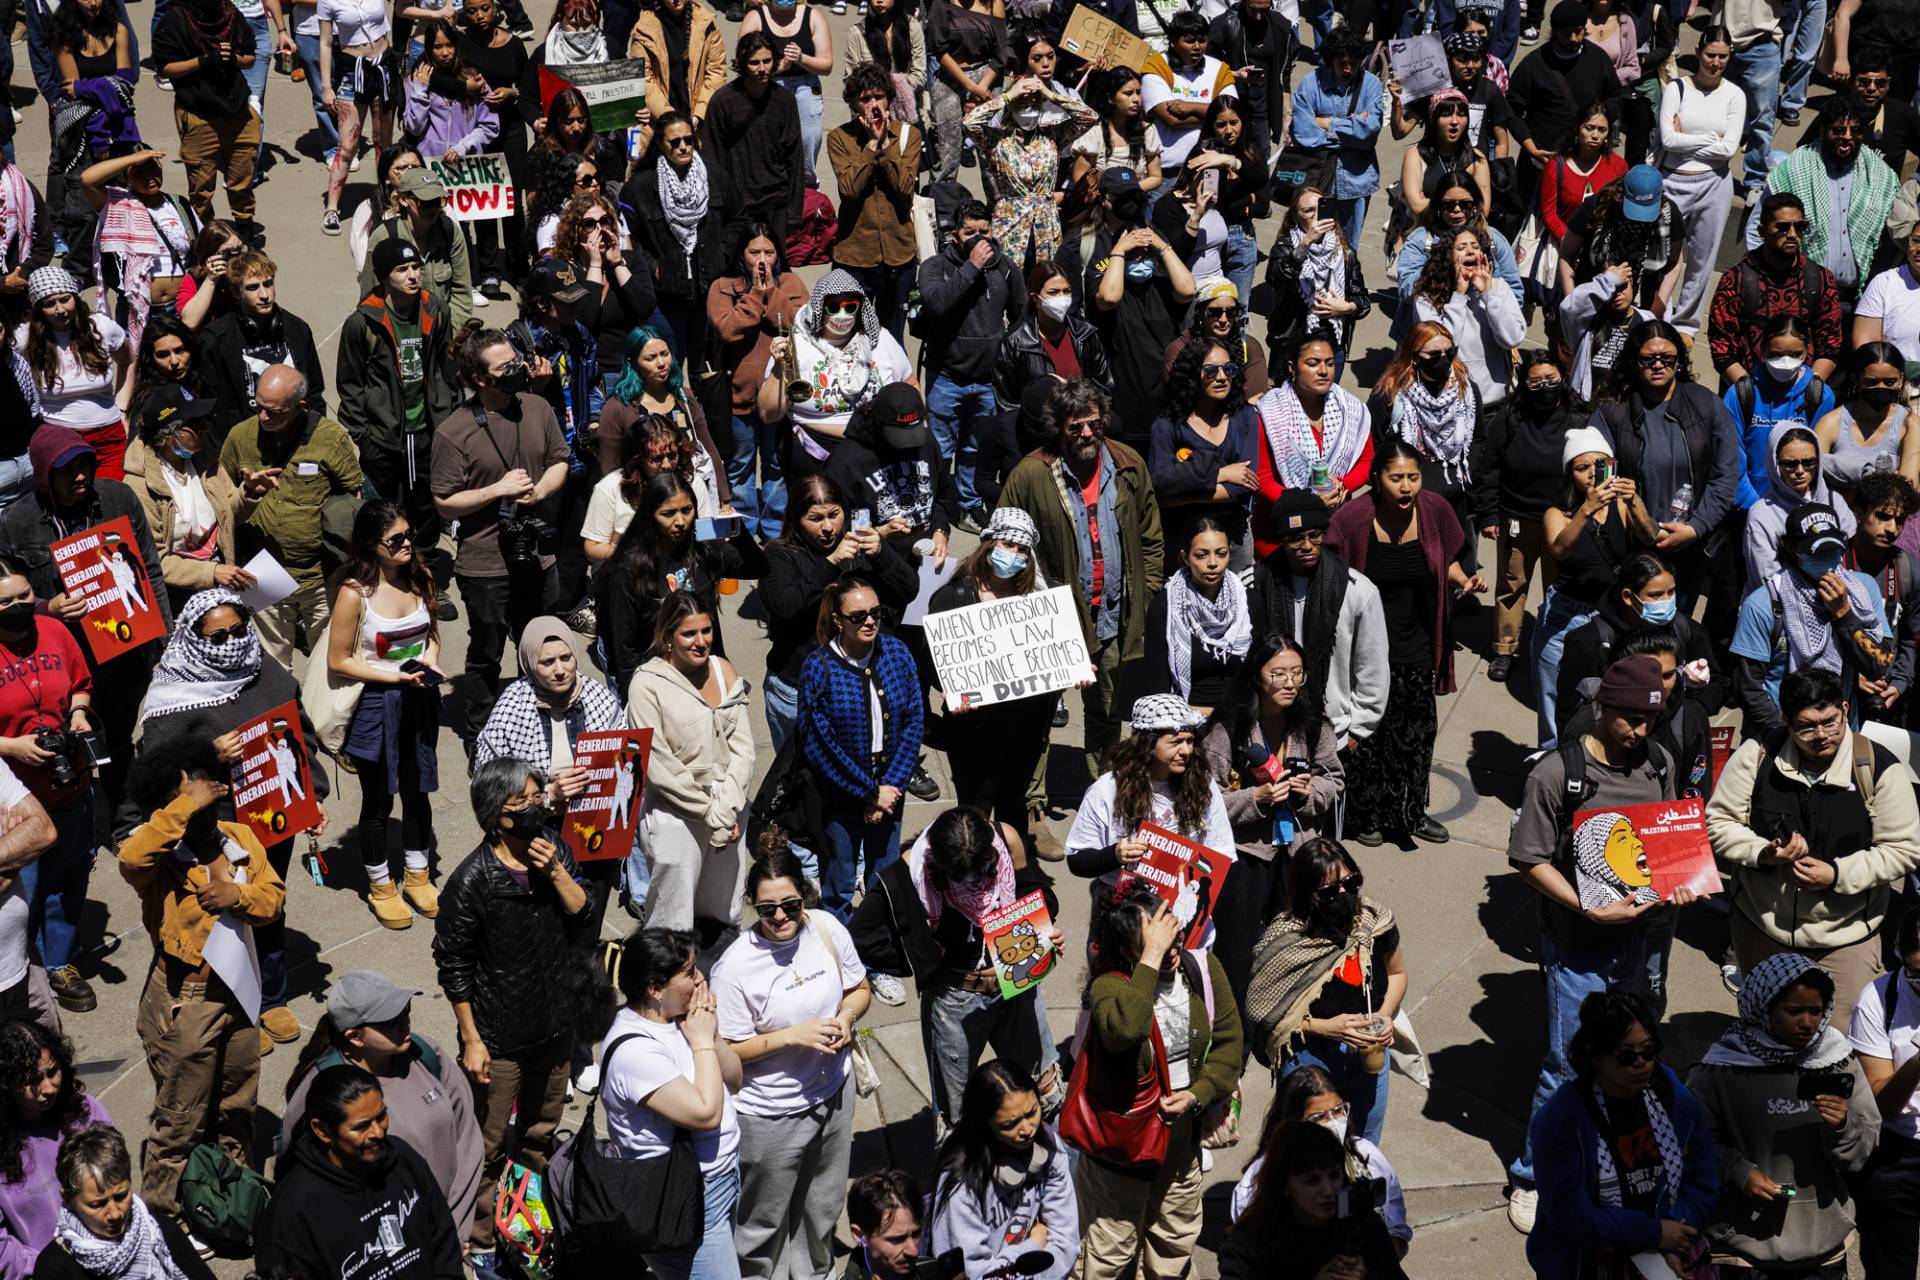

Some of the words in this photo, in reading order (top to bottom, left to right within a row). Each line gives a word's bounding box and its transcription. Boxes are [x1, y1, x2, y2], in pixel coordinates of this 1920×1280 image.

[1082, 16, 1132, 50] CEASE
[1083, 39, 1122, 68] FIRE
[53, 534, 100, 562] GENERATION
[63, 562, 106, 588] GENERATION
[86, 586, 121, 612] ERATION
[925, 611, 976, 643] WHEN
[979, 593, 1060, 632] OPPRESSION
[932, 634, 997, 668] BECOMES
[1010, 617, 1055, 647] LAW
[939, 653, 1019, 694] RESISTANCE
[1024, 638, 1085, 673] BECOMES
[240, 720, 269, 745] ERATION
[577, 737, 622, 753] GENERATION
[588, 768, 615, 780] RATION
[235, 775, 281, 809] LIBERATION
[567, 795, 615, 813] LIBERATION
[1656, 803, 1700, 824] فلسطين
[1640, 827, 1670, 835] PALESTINA
[1139, 829, 1193, 862] GENERATION
[981, 913, 1001, 924] HOLA
[1001, 901, 1025, 915] GATITA
[1025, 892, 1041, 903] DICE
[392, 1247, 421, 1267] RANCISCO
